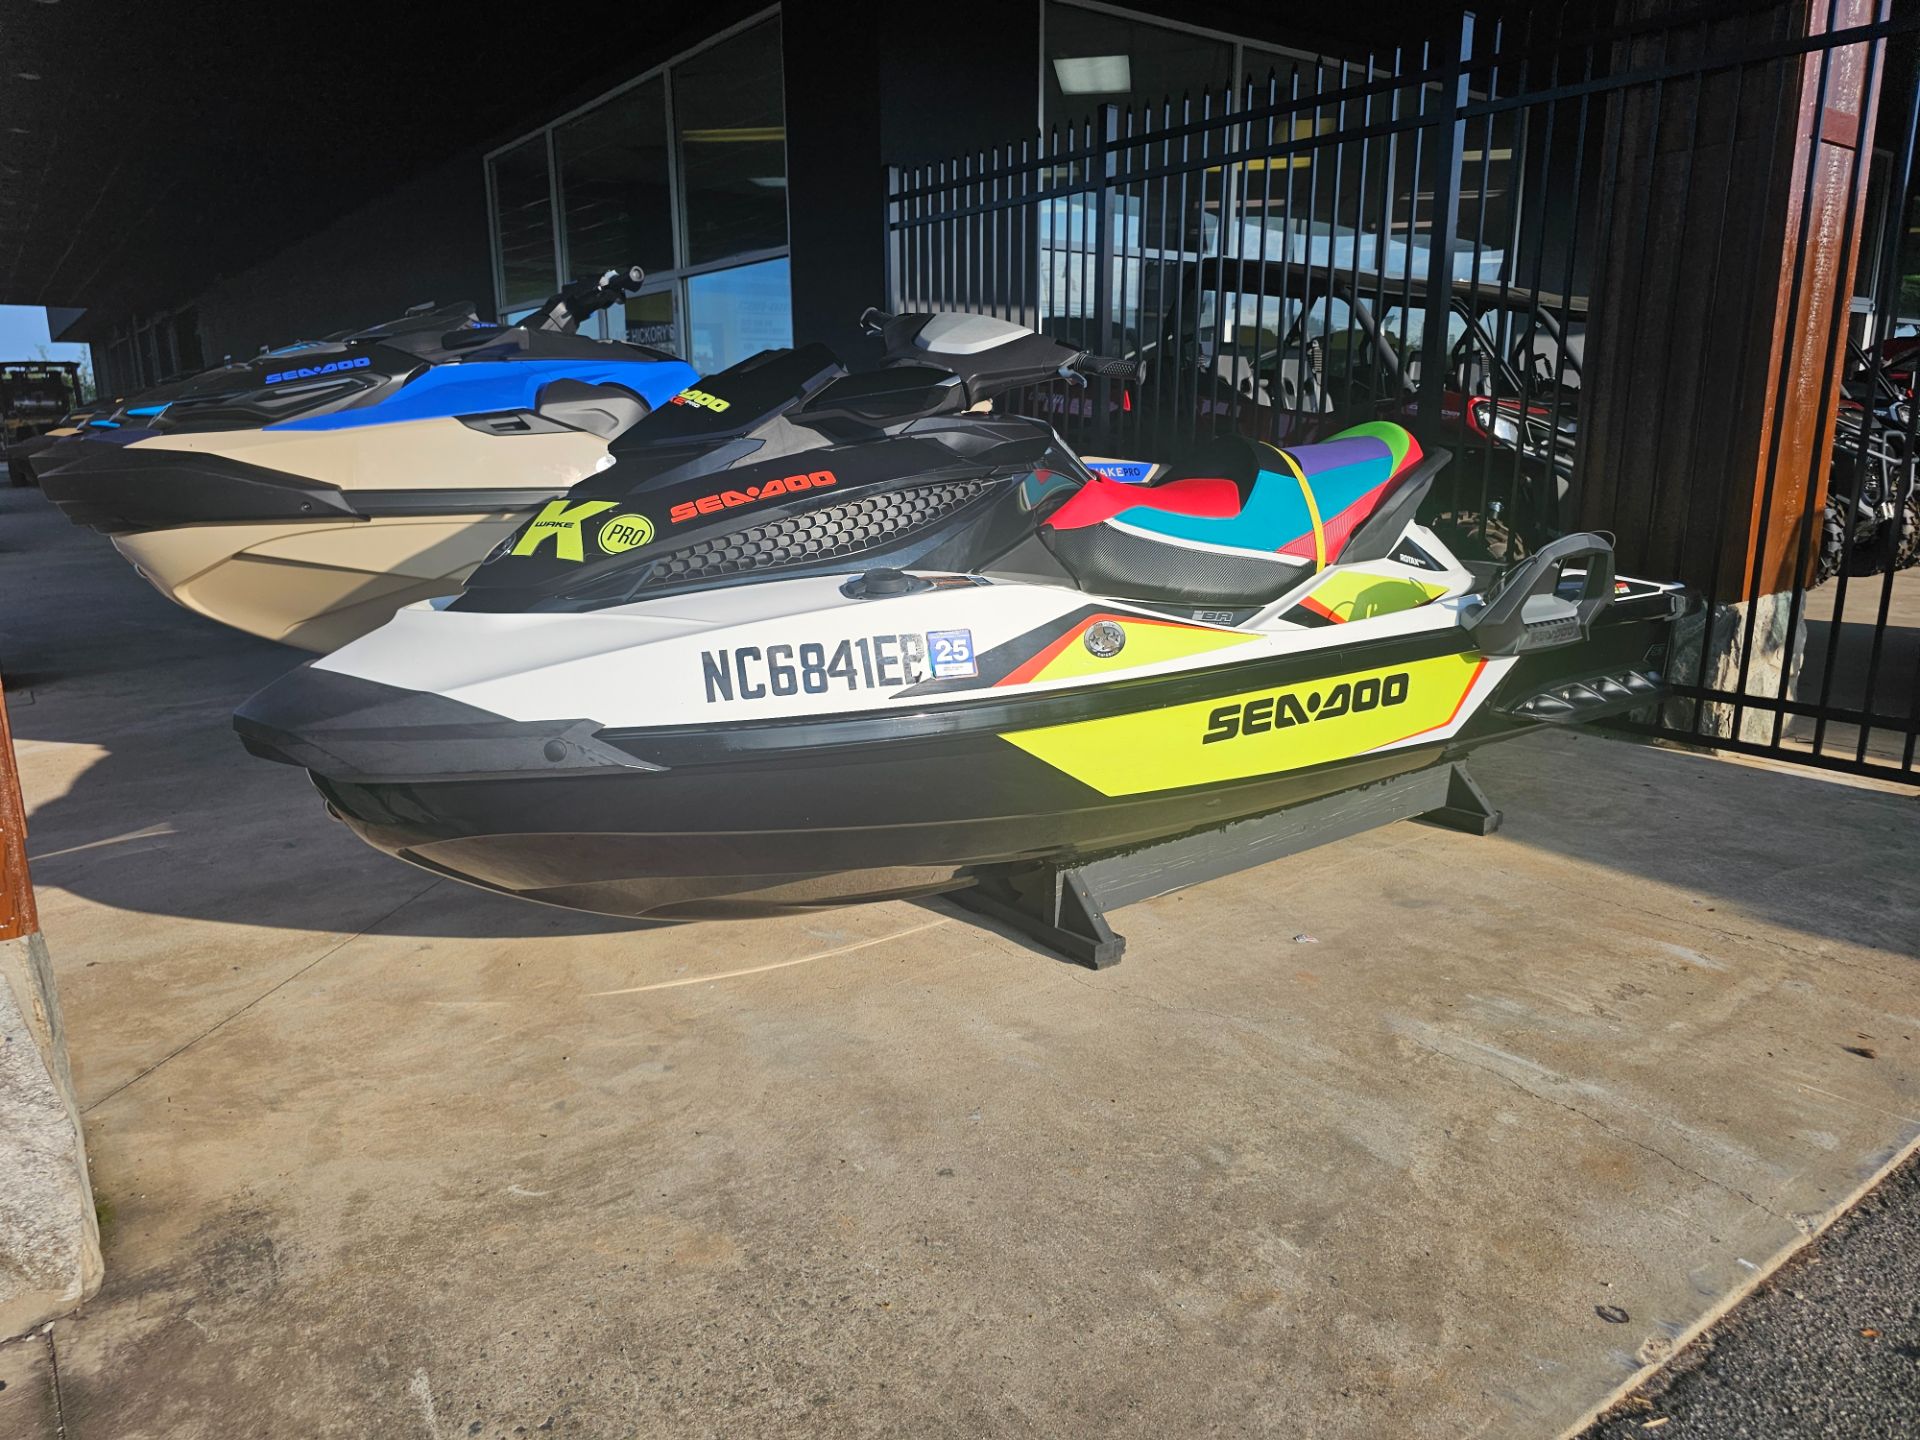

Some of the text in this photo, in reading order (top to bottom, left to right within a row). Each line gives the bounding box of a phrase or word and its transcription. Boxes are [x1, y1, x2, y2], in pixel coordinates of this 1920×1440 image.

[534, 521, 574, 529] WAKE
[607, 523, 646, 547] PRO
[935, 639, 970, 662] 25
